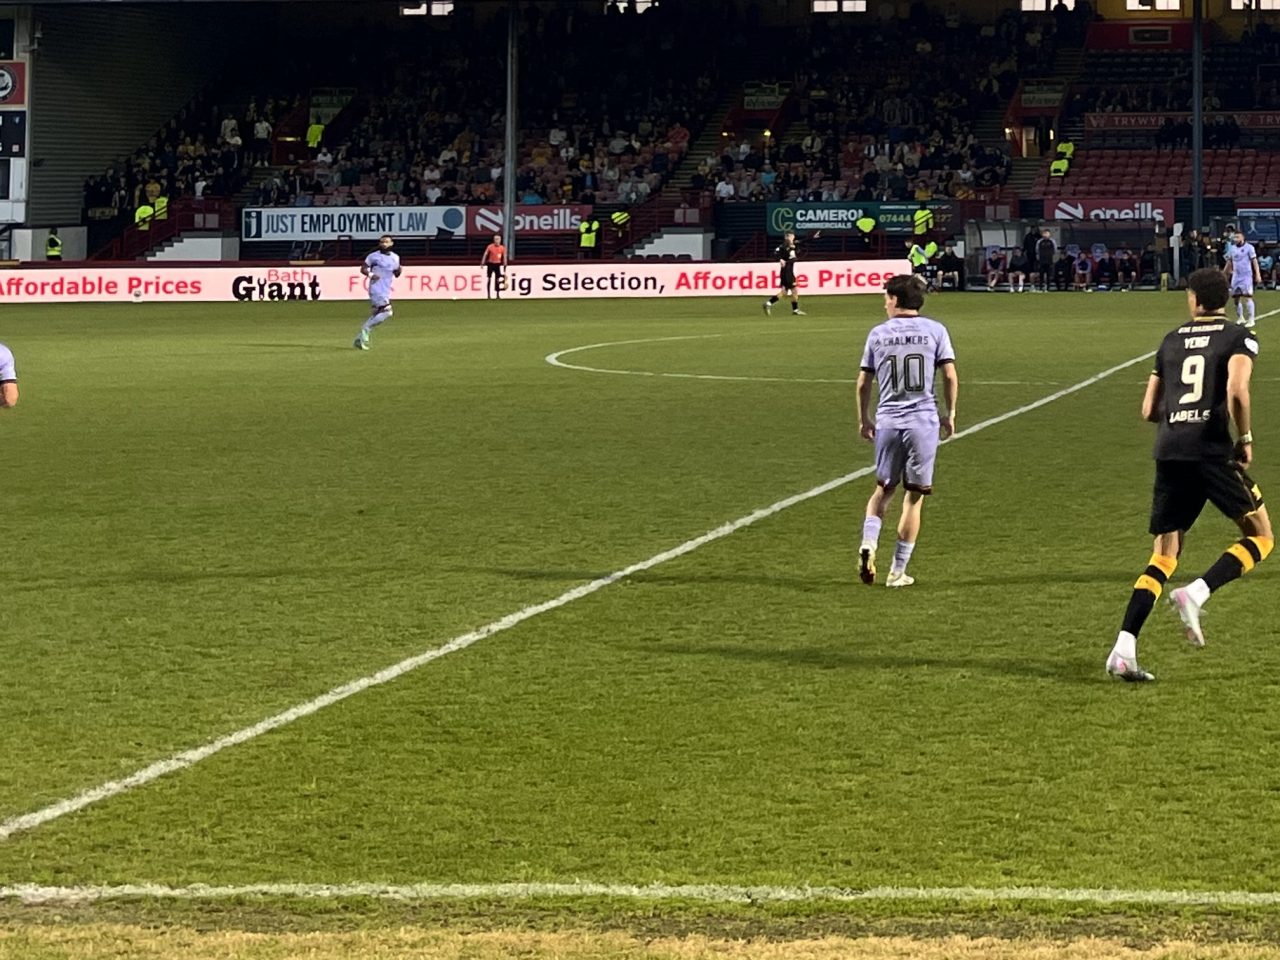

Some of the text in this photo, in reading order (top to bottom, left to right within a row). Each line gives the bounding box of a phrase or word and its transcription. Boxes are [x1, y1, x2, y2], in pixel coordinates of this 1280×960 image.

[265, 212, 428, 234] JUST EMPLOYMENT LAW
[127, 275, 202, 296] Prices
[267, 269, 312, 282] Bath
[405, 274, 483, 292] TRADE
[542, 272, 665, 294] Selection,
[674, 270, 809, 290] Affordabe
[818, 270, 895, 290] Prices
[232, 274, 322, 302] Giant
[884, 336, 929, 347] CHALMERS
[886, 353, 926, 393] 10
[1178, 354, 1206, 405] 9
[1170, 409, 1202, 424] LABEL
